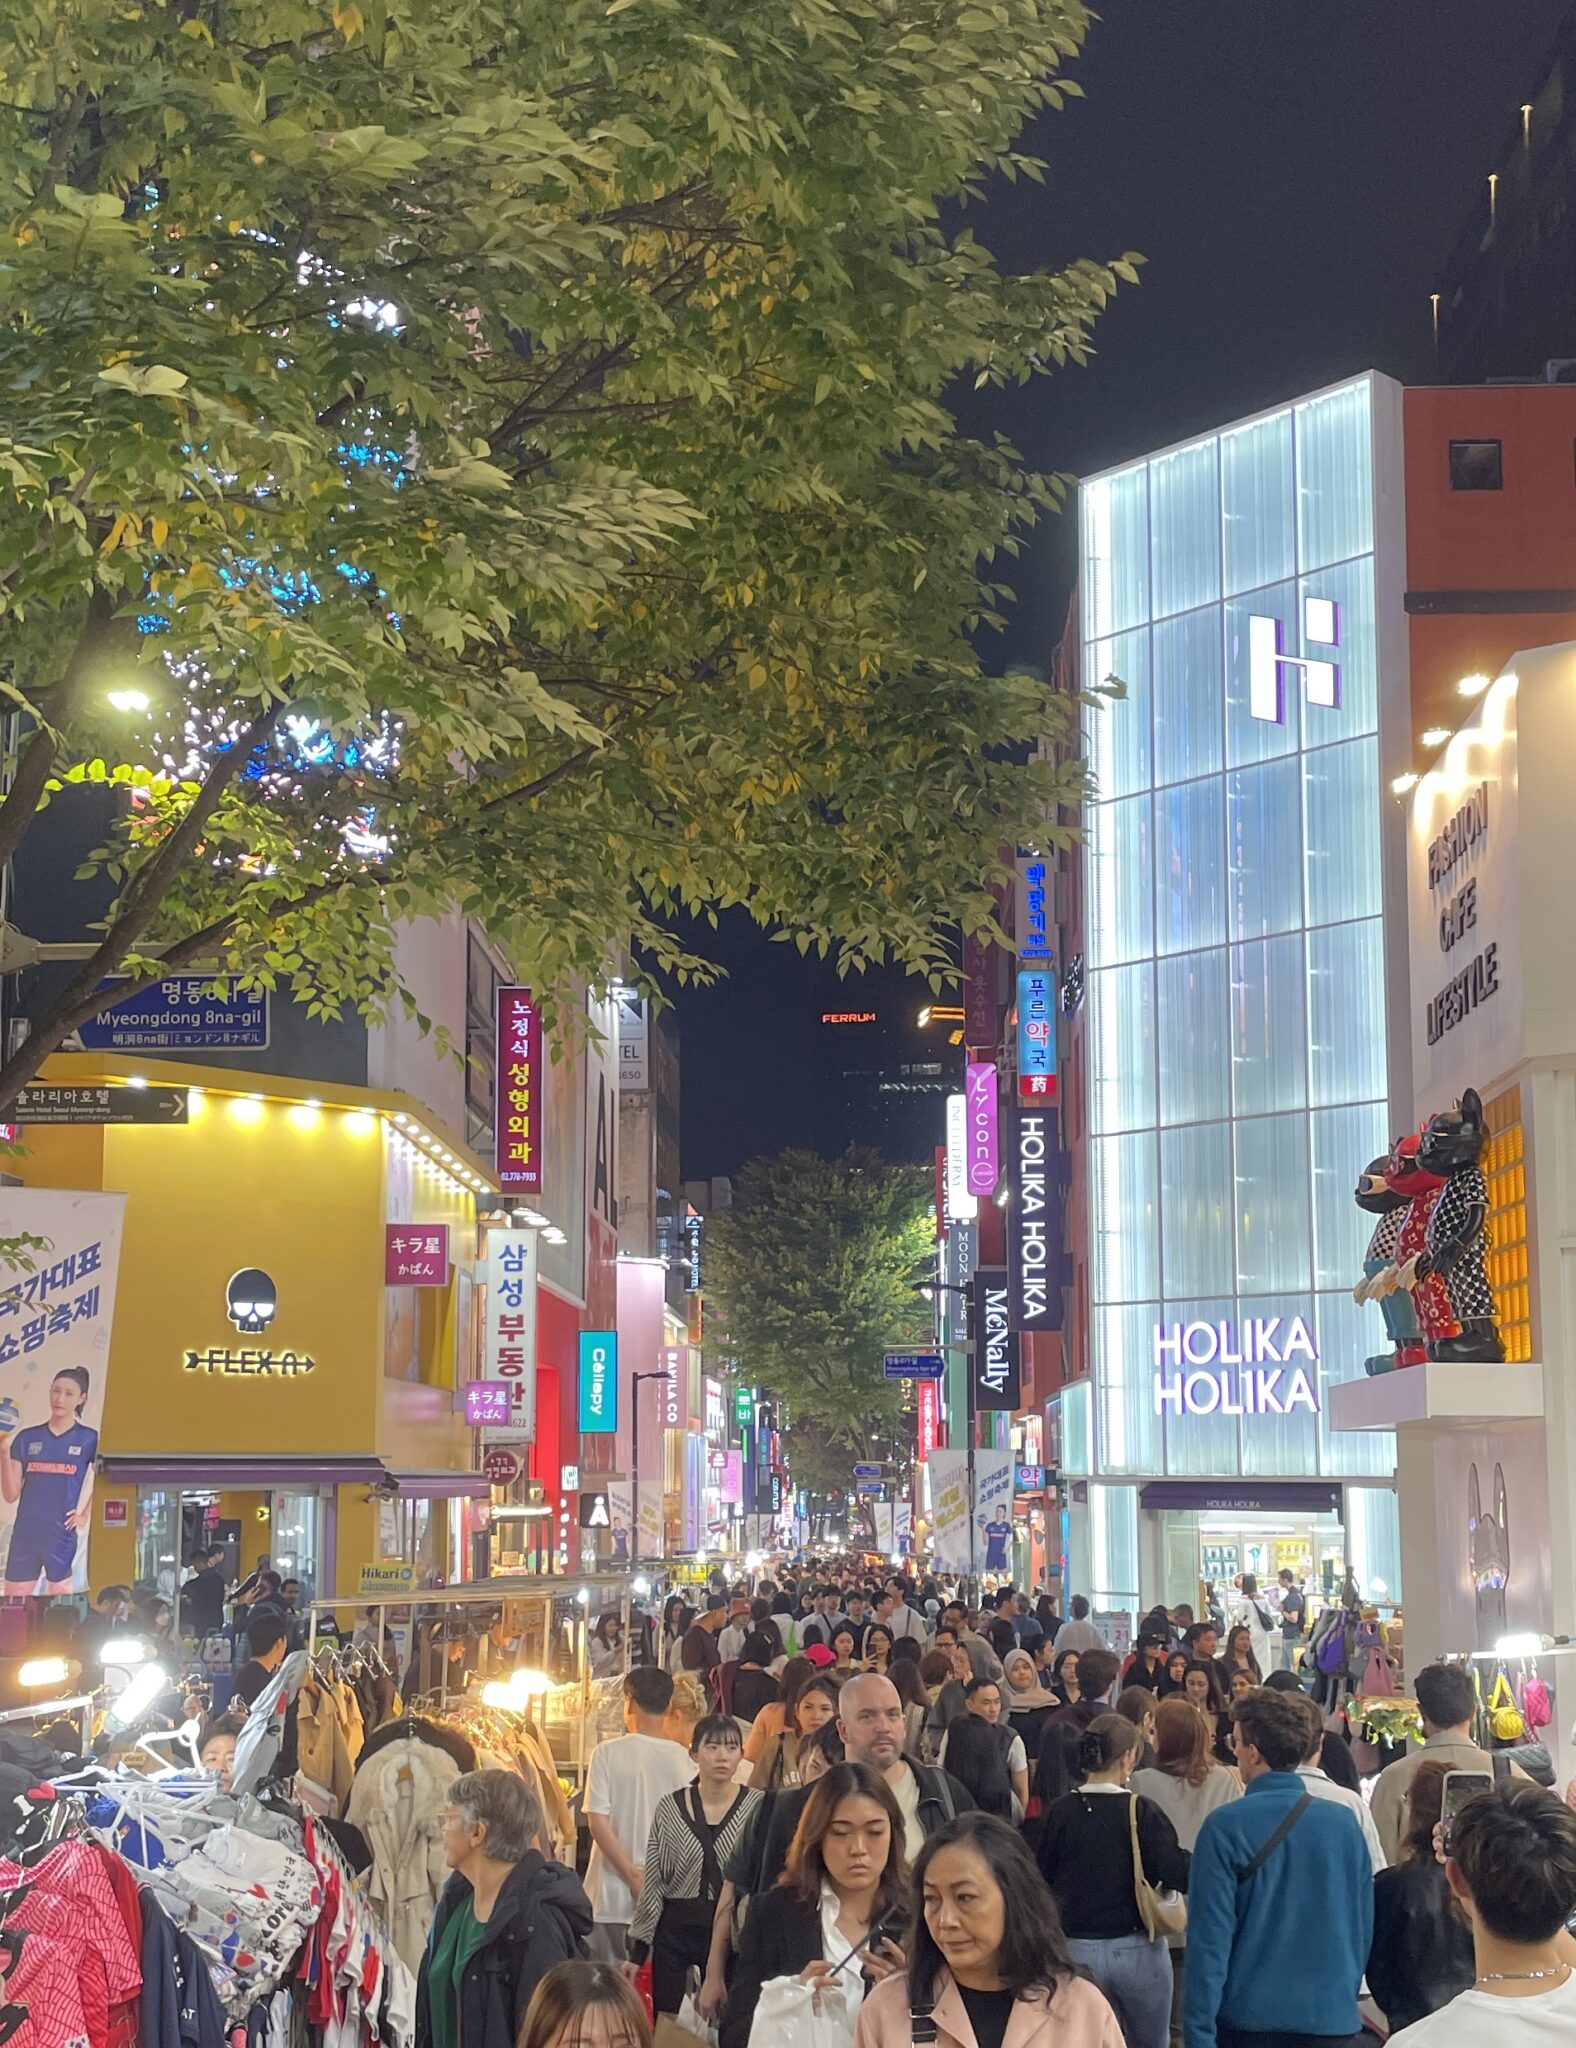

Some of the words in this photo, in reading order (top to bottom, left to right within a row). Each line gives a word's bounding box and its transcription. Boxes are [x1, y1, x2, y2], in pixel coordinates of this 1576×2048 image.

[1428, 781, 1488, 889] FASHION
[1439, 877, 1477, 952] CAFE
[1427, 942, 1498, 1046] LIFESTYLE
[97, 1010, 200, 1028] Myeongdong
[205, 1009, 261, 1029] 8na-gil
[510, 1000, 532, 1058] 노정식
[822, 1013, 876, 1023] FERRUM
[1026, 979, 1051, 1069] 푸른약국
[15, 1089, 110, 1105] 솔라리아호텔
[1031, 1076, 1048, 1093] 药
[507, 1063, 533, 1165] 성형외과
[1020, 1117, 1045, 1214] HOLIKA
[391, 1236, 441, 1254] キラ星
[958, 1231, 969, 1274] MOON
[398, 1263, 434, 1276] かばん
[1022, 1222, 1047, 1319] HOLIKA
[981, 1287, 1010, 1394] McNally
[1153, 1316, 1320, 1366] HOLIKA
[466, 1390, 508, 1406] キラ星
[472, 1409, 502, 1420] かばん
[1154, 1368, 1321, 1416] HOLIKA
[1020, 1466, 1041, 1489] 약
[361, 1567, 400, 1579] Hikari
